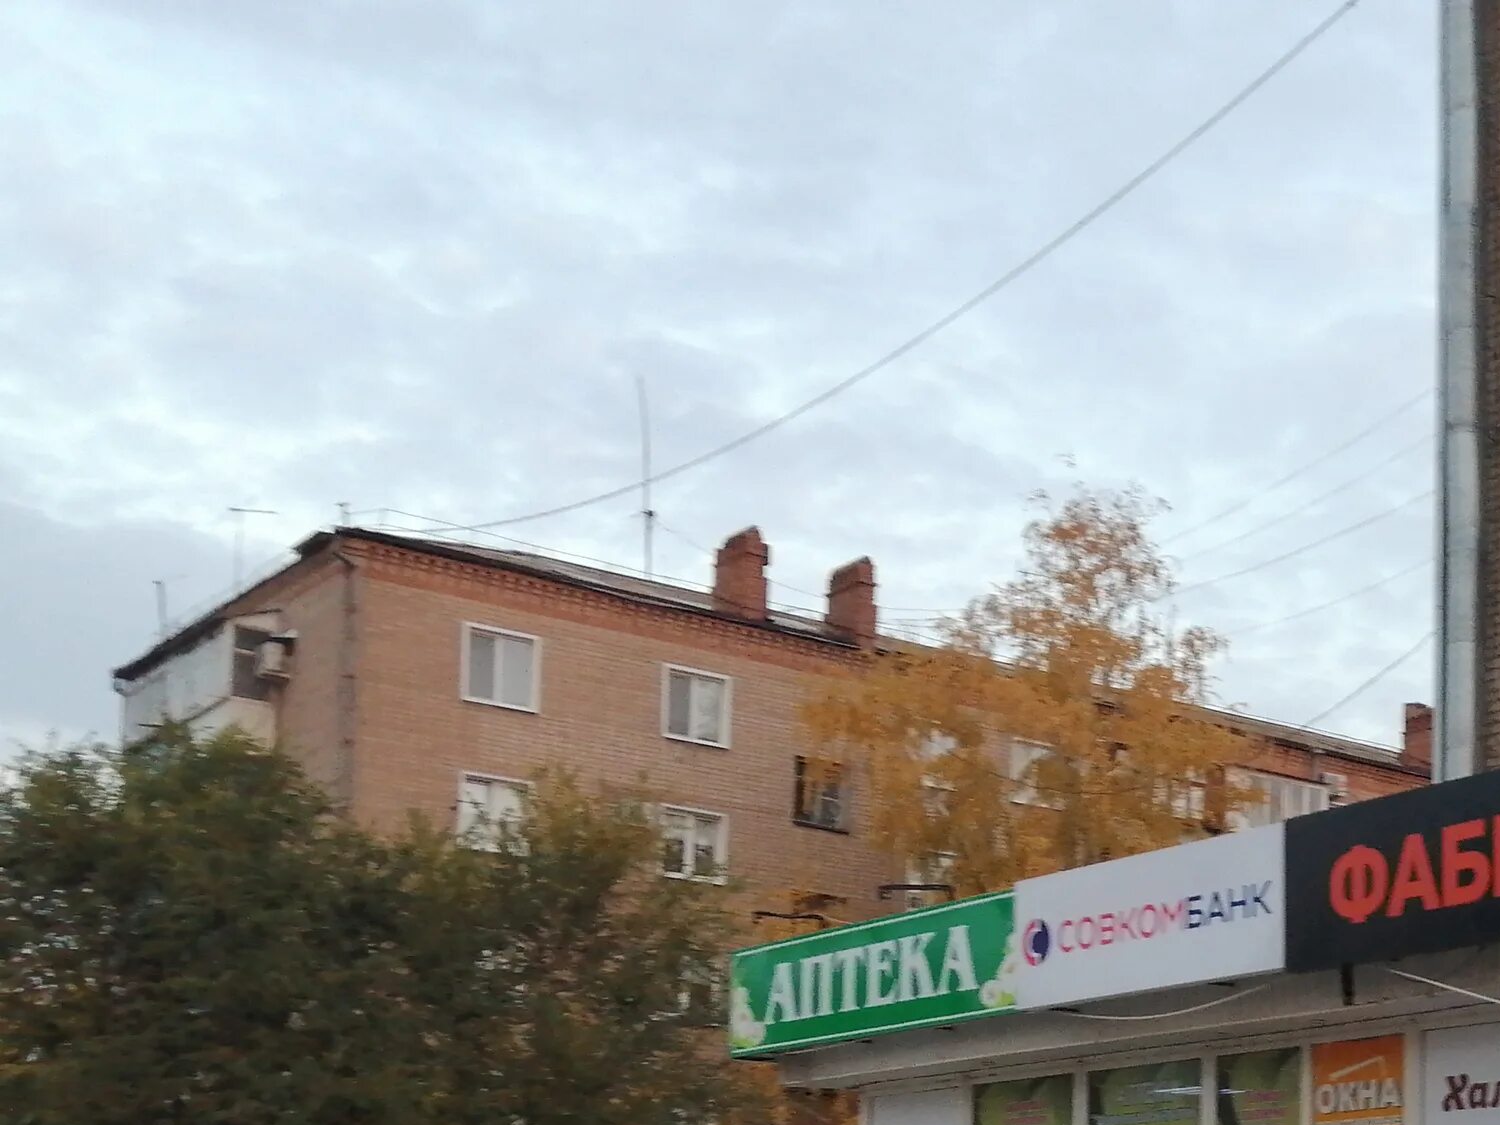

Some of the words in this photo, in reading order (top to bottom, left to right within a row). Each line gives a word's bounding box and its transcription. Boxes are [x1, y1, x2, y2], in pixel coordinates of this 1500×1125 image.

[1057, 880, 1274, 954] СОВКОМБАНК
[764, 924, 979, 1024] АПТЕКА
[1315, 1077, 1401, 1114] ОКНА
